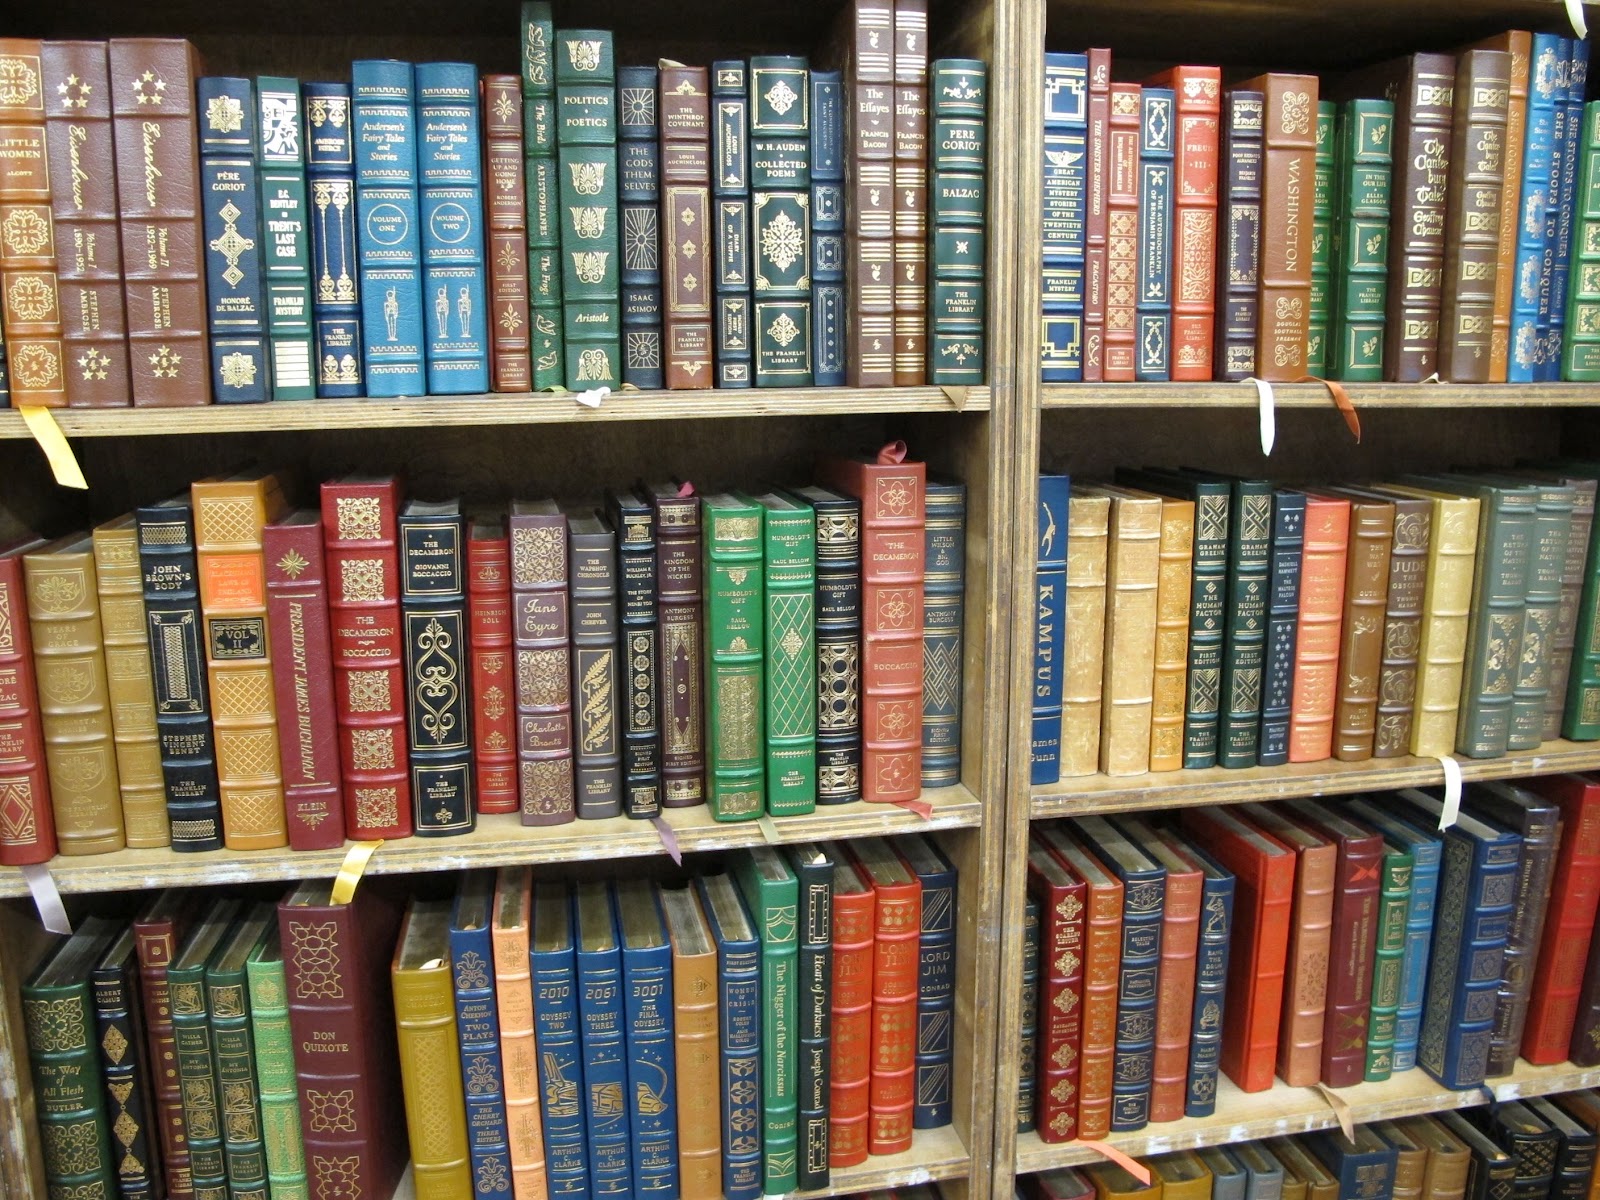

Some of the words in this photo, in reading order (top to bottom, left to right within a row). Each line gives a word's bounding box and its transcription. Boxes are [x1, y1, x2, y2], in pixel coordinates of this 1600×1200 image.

[866, 89, 884, 99] The
[902, 91, 920, 101] The
[564, 96, 609, 105] POLITICS
[536, 106, 545, 122] The
[362, 123, 405, 131] Andersen's
[426, 123, 467, 131] Andersen's
[566, 118, 608, 127] POETICS
[1555, 112, 1564, 140] SHE
[1569, 116, 1578, 138] SHE
[363, 134, 384, 144] Fairy
[385, 134, 405, 143] Tales
[426, 134, 448, 144] Fairy
[448, 134, 468, 143] Tales
[536, 124, 546, 144] Birds
[950, 130, 975, 139] PERE
[0, 139, 40, 148] LITTLE
[942, 141, 981, 151] GORIOT
[0, 150, 41, 159] WOMEN
[370, 153, 398, 161] Stories
[434, 153, 461, 161] Stories
[629, 148, 649, 156] THE
[626, 159, 654, 168] GODS
[756, 161, 807, 169] COLLECTED
[1565, 141, 1576, 184] STOOPS
[624, 171, 655, 179] THEM-
[1550, 152, 1561, 205] STOOPS
[212, 184, 246, 192] GORIOT
[624, 182, 656, 191] SELVES
[943, 189, 980, 199] BALZAC
[1151, 190, 1156, 199] OF
[1563, 187, 1572, 202] TO
[536, 165, 548, 236] ARISTOPHANES
[1286, 158, 1301, 272] WASHINGTON
[1547, 219, 1555, 238] TO
[1558, 204, 1571, 258] CONQUER
[276, 234, 296, 245] LAST
[276, 246, 296, 257] CASE
[541, 256, 550, 273] The
[540, 275, 550, 296] Frogs
[1540, 249, 1553, 315] CONQUER
[80, 288, 90, 332] AMBROSE
[90, 290, 100, 330] STEPHEN
[152, 286, 162, 330] AMBROSE
[162, 288, 172, 328] STEPHEN
[575, 313, 609, 323] Aristotle
[885, 542, 905, 550] THE
[873, 553, 919, 561] DECAMERON
[153, 565, 181, 574] JOHN
[1393, 562, 1425, 573] JUDE
[146, 573, 192, 582] BROWN'S
[155, 582, 183, 590] BODY
[524, 599, 558, 614] Jane
[525, 616, 559, 637] Eyre
[226, 631, 249, 639] VOL
[338, 628, 394, 637] DECAMERON
[290, 602, 307, 675] PRESIDENT
[1037, 584, 1054, 697] KAMPUS
[233, 640, 243, 648] II
[343, 649, 391, 657] BOCCACCIO
[295, 675, 310, 714] JAMES
[526, 721, 566, 734] Charlotte
[163, 734, 205, 742] STEPHEN
[298, 802, 327, 812] KLEIN
[921, 952, 950, 962] LORD
[776, 961, 786, 983] The
[814, 954, 825, 982] Heart
[922, 964, 947, 975] JIM
[634, 985, 664, 997] 3001
[814, 983, 825, 992] of
[921, 983, 950, 993] CONRAD
[540, 987, 570, 999] 2010
[586, 987, 616, 999] 2061
[774, 986, 786, 1018] Nigger
[541, 1011, 571, 1021] ODYSSEY
[587, 1012, 617, 1021] ODYSSEY
[639, 1011, 659, 1019] FINAL
[814, 994, 825, 1039] Darkness
[591, 1022, 615, 1030] THREE
[634, 1018, 664, 1027] ODYSSEY
[777, 1020, 786, 1032] of
[313, 1032, 336, 1040] DON
[463, 1032, 494, 1040] PLAYS
[777, 1033, 786, 1047] the
[303, 1043, 349, 1053] QUIXOTE
[810, 1049, 823, 1080] Joseph
[39, 1066, 56, 1076] The
[59, 1066, 81, 1076] Way
[776, 1047, 785, 1097] Narcissus
[56, 1076, 66, 1086] of
[43, 1088, 56, 1097] All
[60, 1086, 84, 1096] Flesh
[814, 1081, 823, 1110] Conrad
[47, 1102, 83, 1112] BUTLER
[768, 1121, 795, 1130] Conrad
[553, 1147, 582, 1156] ARTHUR
[597, 1147, 625, 1156] ARTHUR
[641, 1145, 670, 1153] ARTHUR
[554, 1160, 581, 1168] CLARKE
[598, 1160, 626, 1168] CLARKE
[643, 1157, 669, 1166] CLARKE
